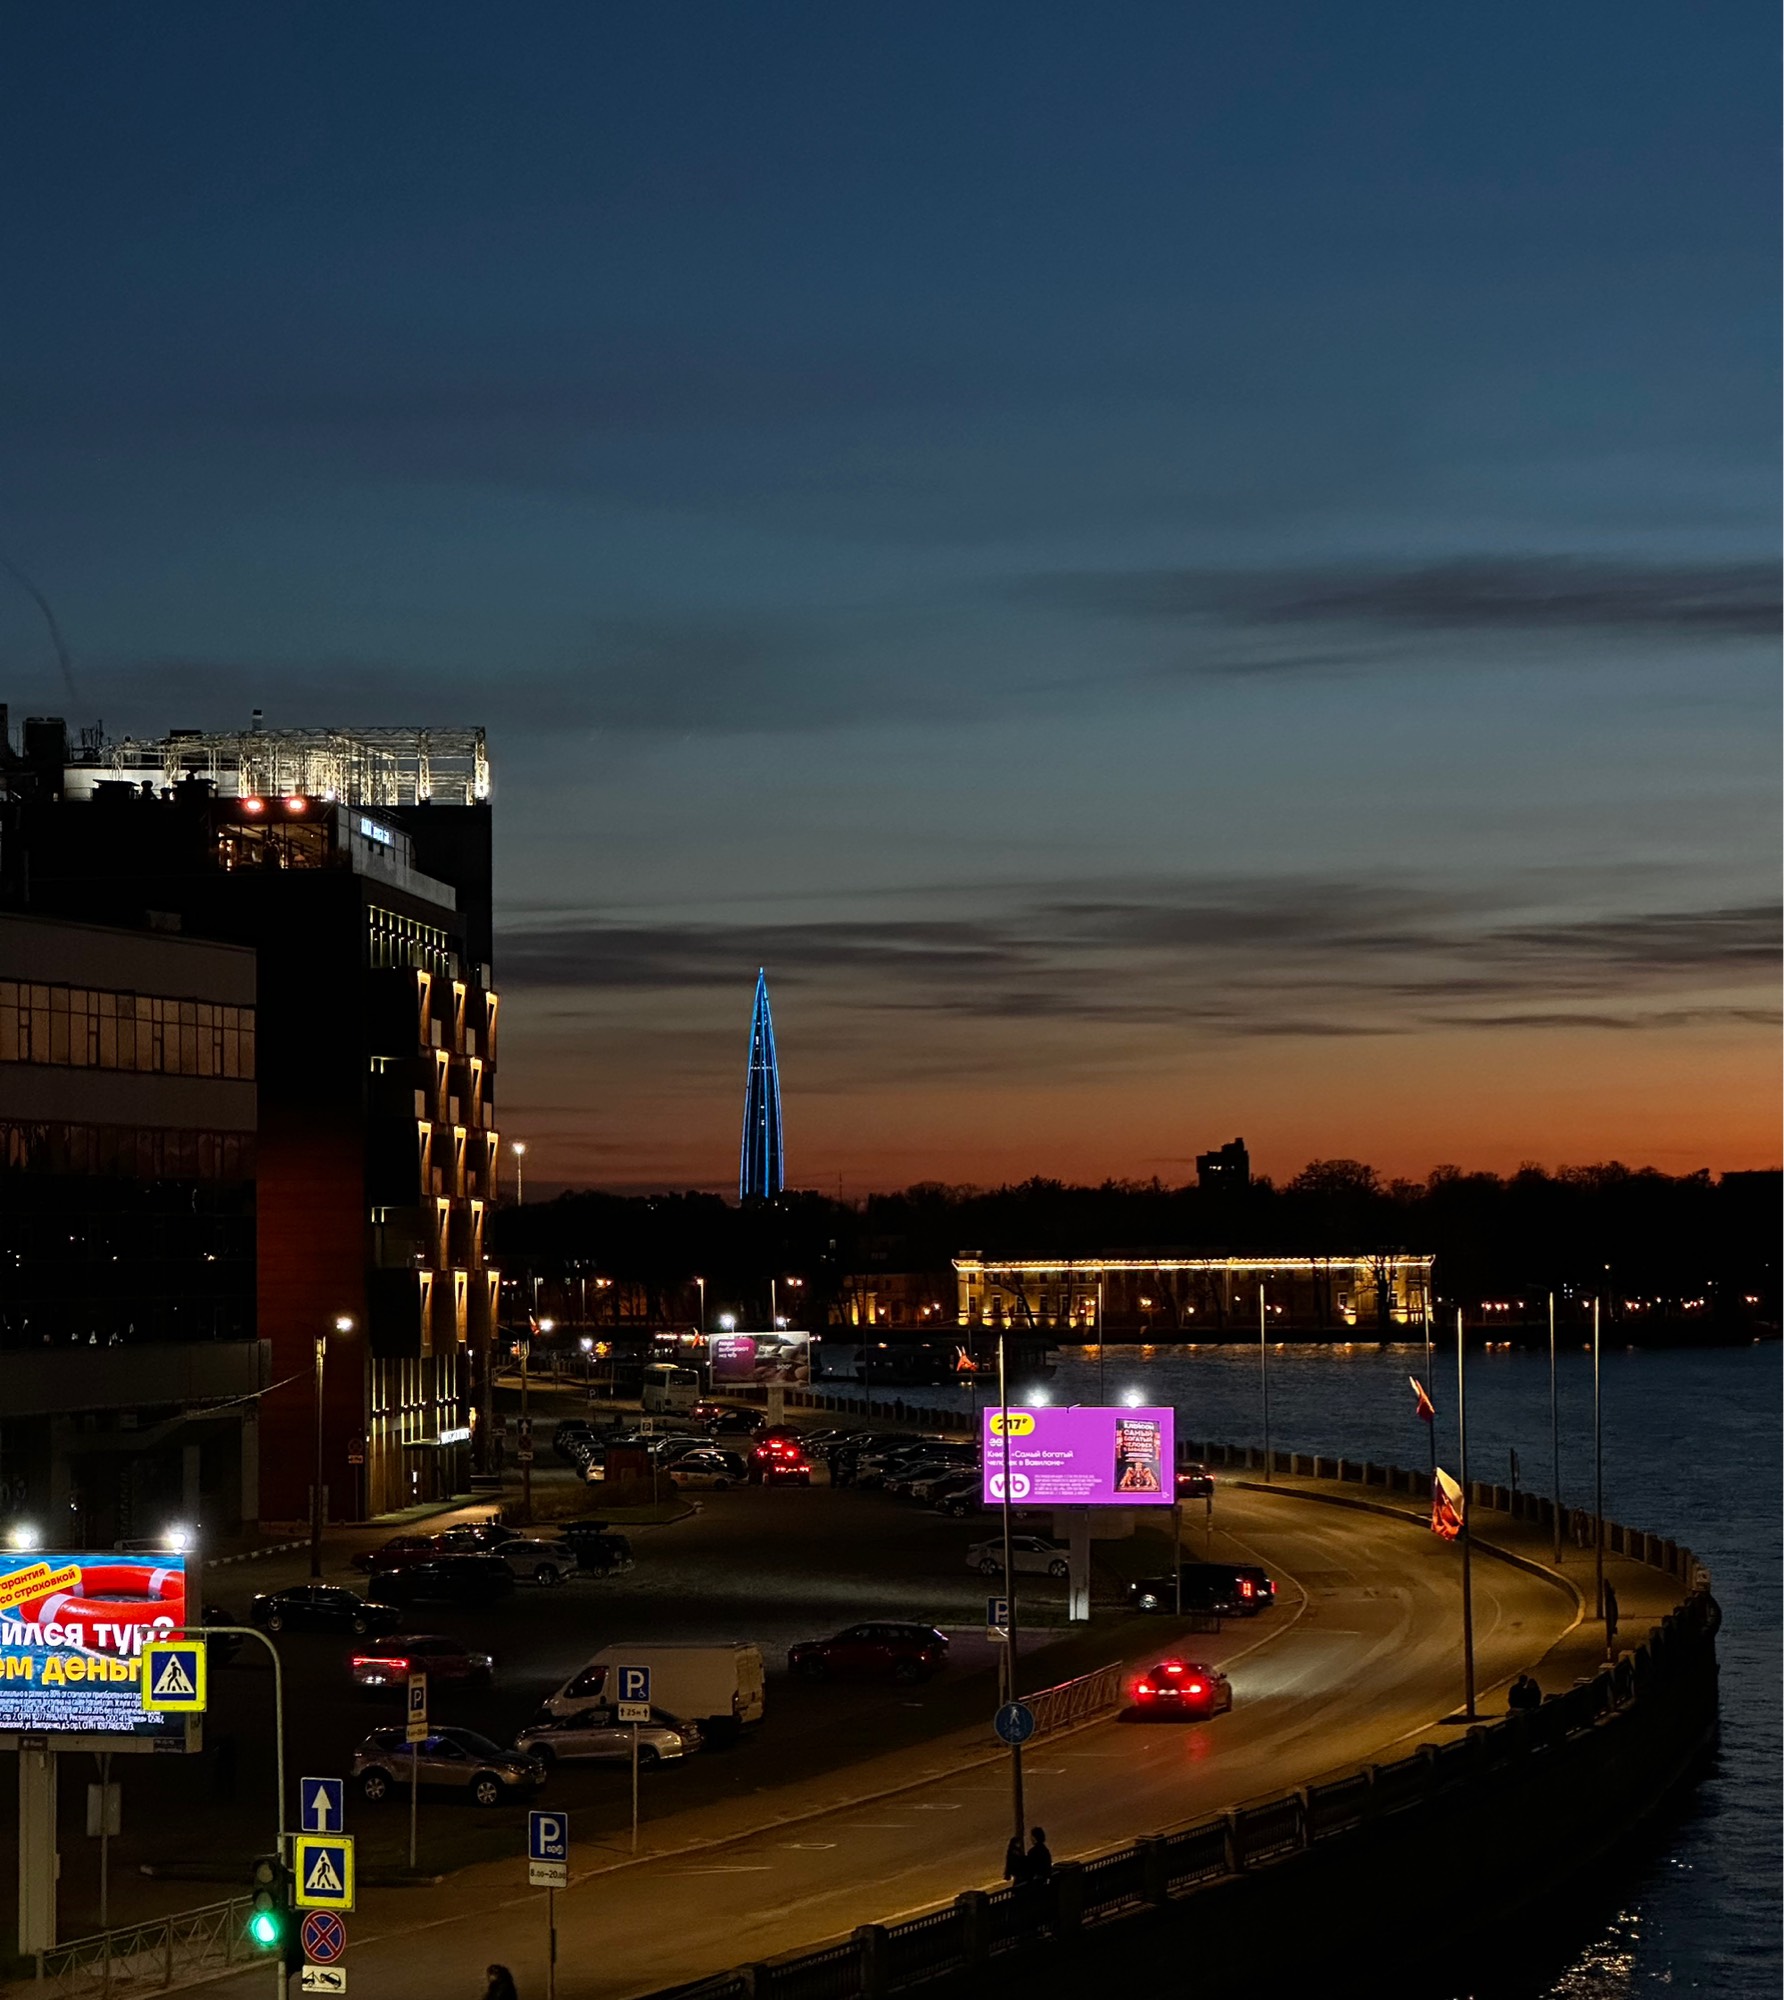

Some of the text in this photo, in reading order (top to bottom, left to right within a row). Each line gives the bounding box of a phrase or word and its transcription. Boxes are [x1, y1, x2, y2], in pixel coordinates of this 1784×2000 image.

[1042, 1450, 1074, 1458] богатый
[14, 1568, 77, 1597] страховкой
[627, 1670, 645, 1698] P
[414, 1690, 422, 1708] P
[540, 1817, 560, 1855] P
